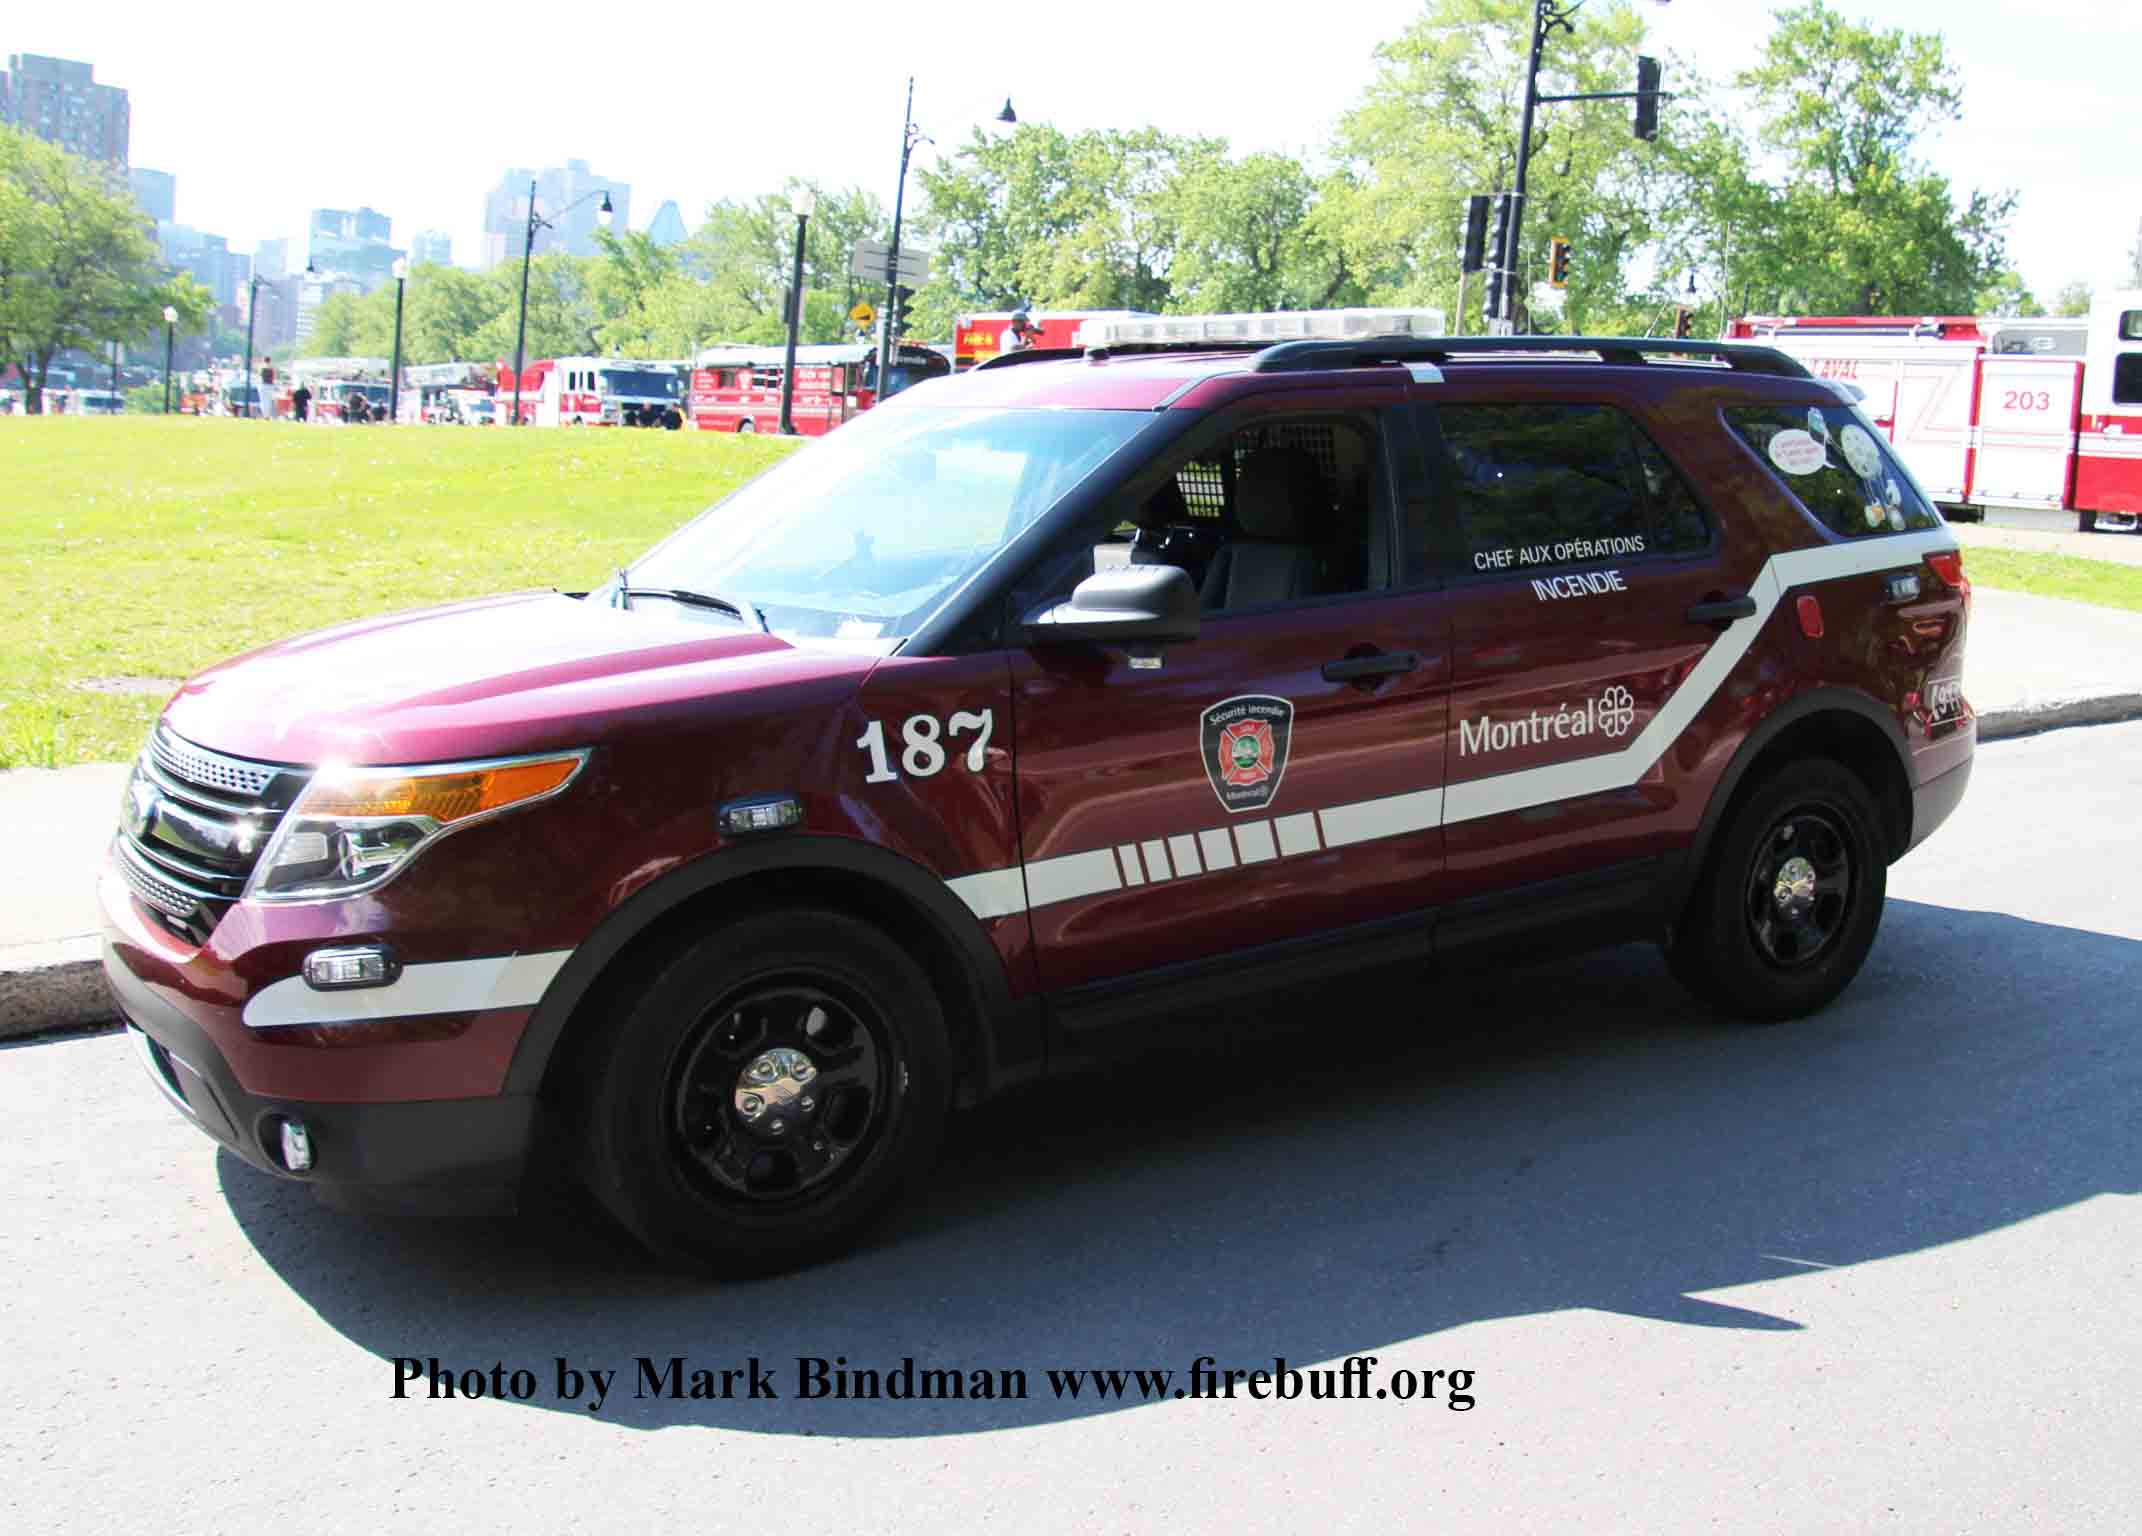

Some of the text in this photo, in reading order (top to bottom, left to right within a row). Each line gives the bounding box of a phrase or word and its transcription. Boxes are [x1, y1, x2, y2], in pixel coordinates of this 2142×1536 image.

[2002, 390, 2050, 410] 203
[1474, 535, 1646, 571] CHEF AUX OPÉRATIONS
[1531, 570, 1628, 601] INCENDIE
[1209, 705, 1247, 724] Sécurité
[1459, 698, 1595, 758] Montréal
[856, 708, 993, 784] 187
